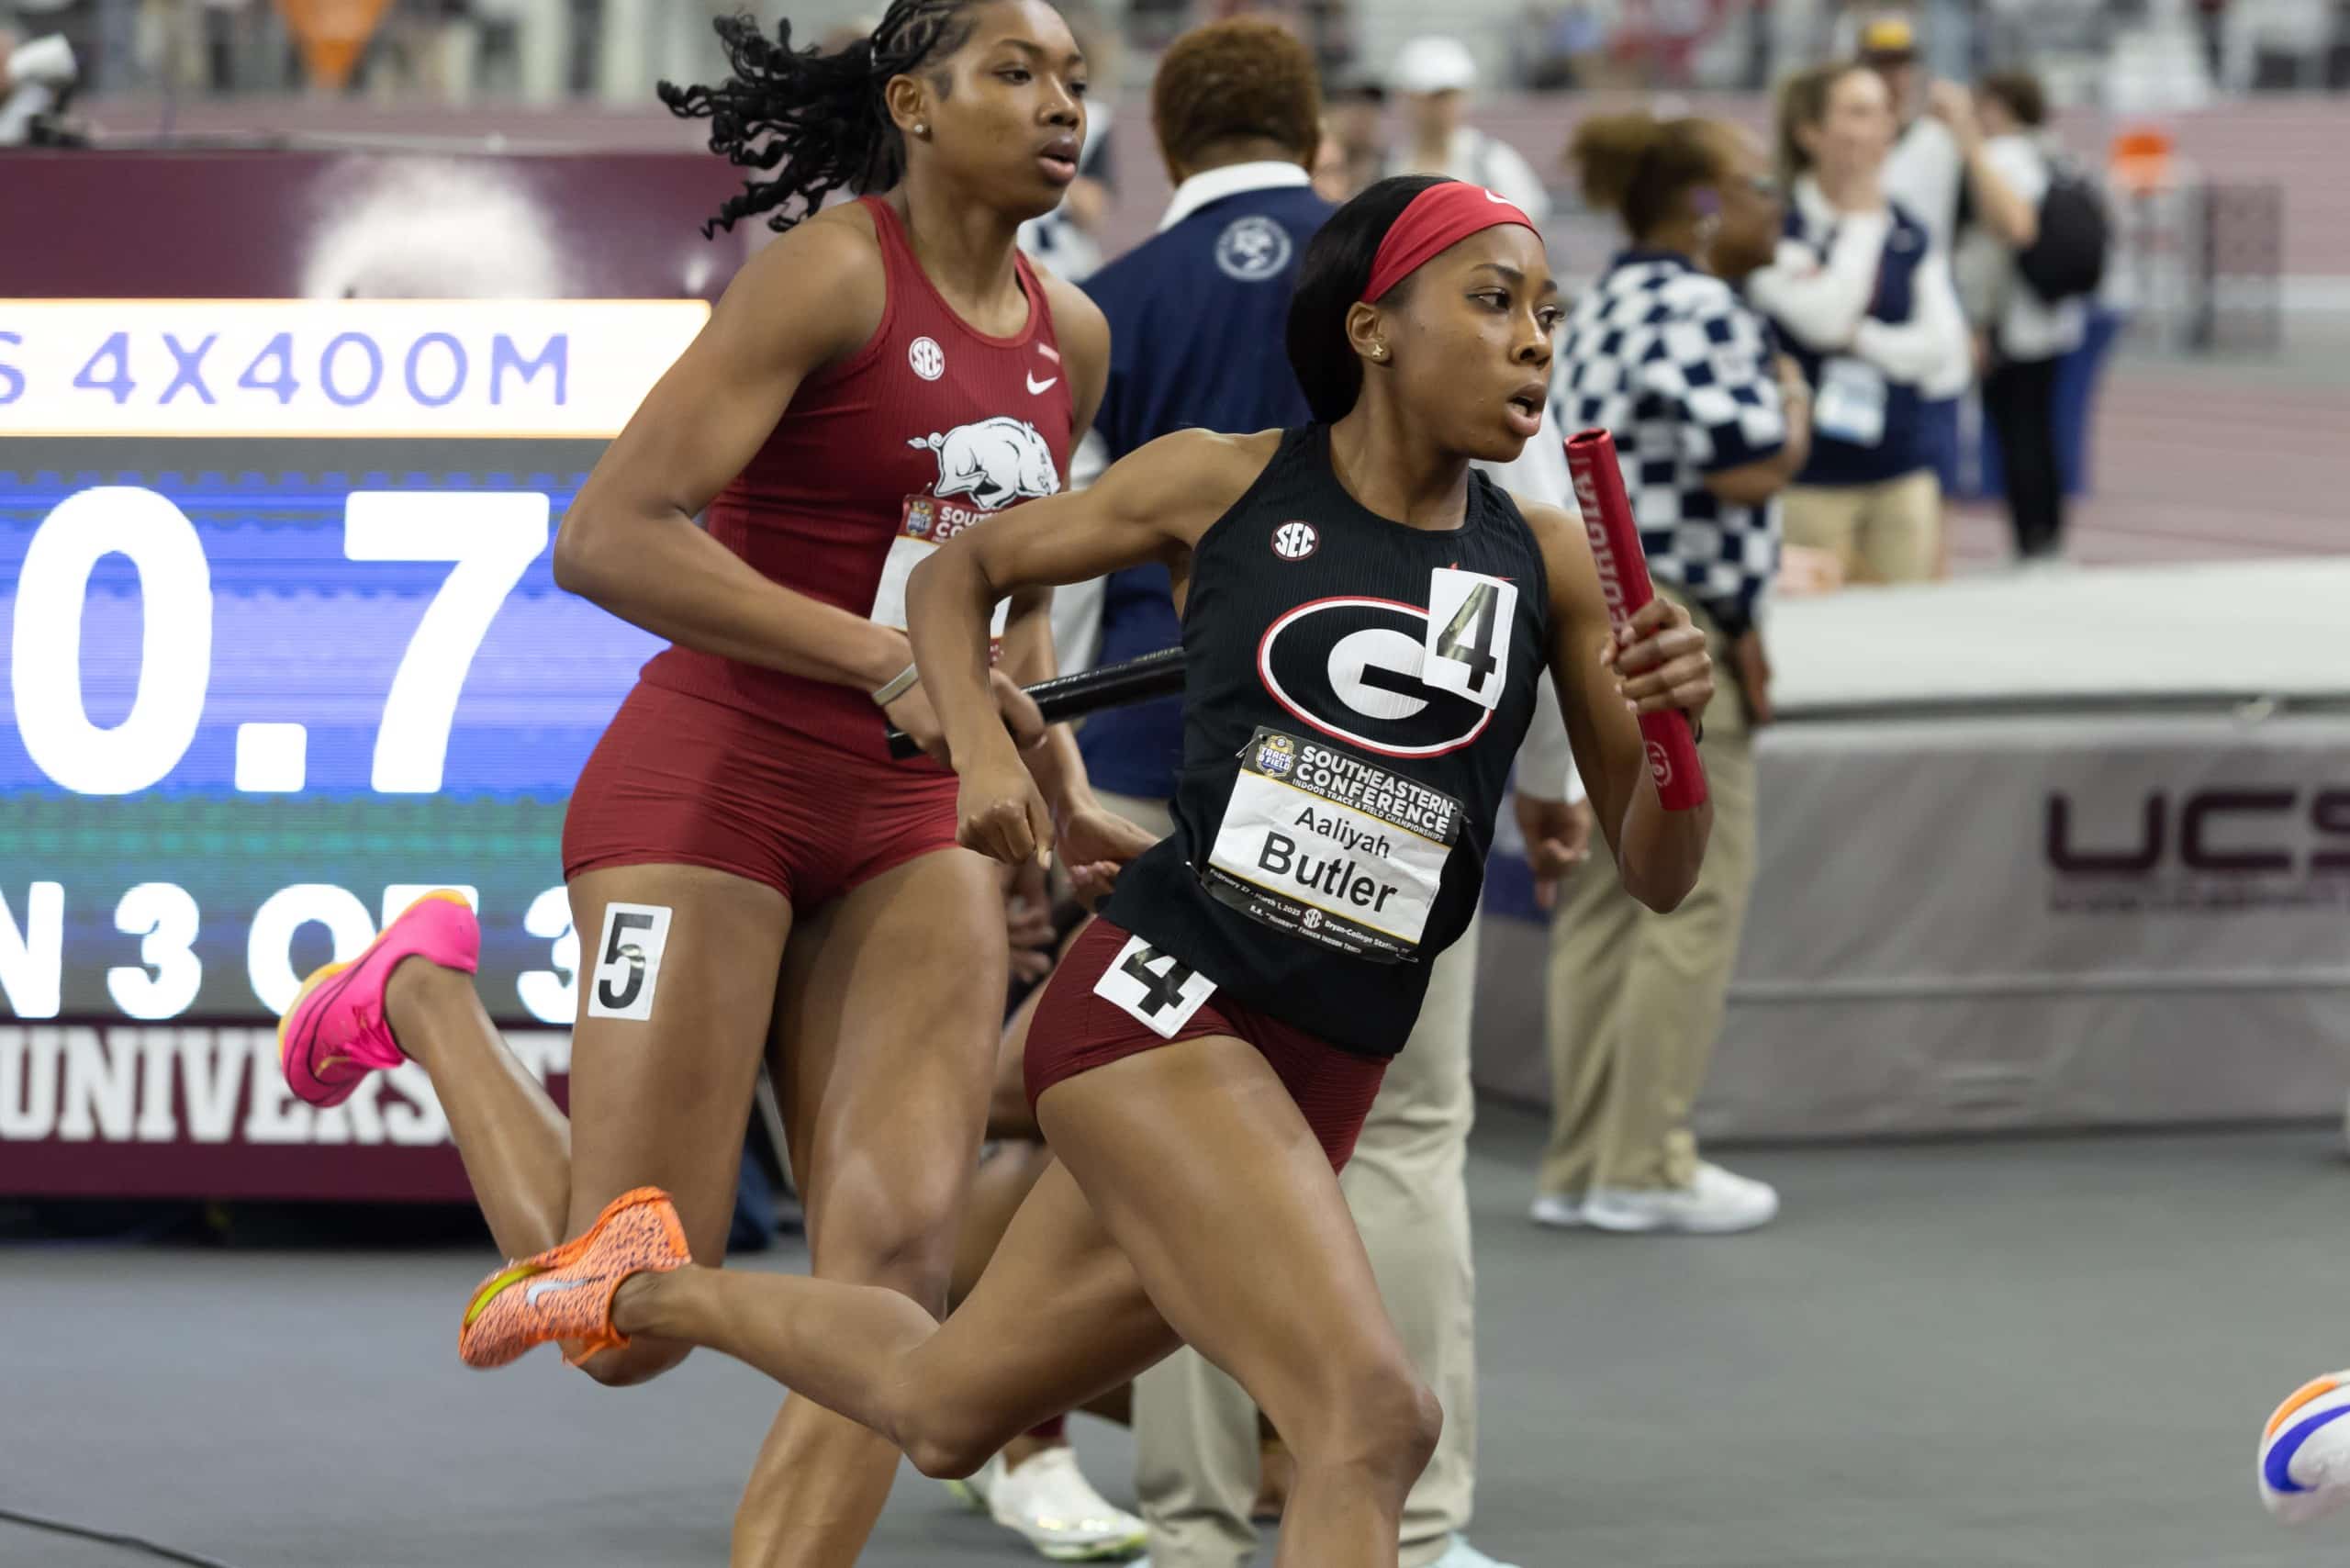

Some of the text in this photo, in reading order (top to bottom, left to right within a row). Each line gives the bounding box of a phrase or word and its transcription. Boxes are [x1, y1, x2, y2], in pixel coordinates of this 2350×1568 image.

[73, 331, 568, 407] 4X400M
[1274, 521, 1315, 558] SEC
[11, 486, 551, 796] 0.7
[1436, 581, 1500, 694] 4
[1265, 756, 1291, 771] FIELD
[1296, 763, 1449, 834] CONFERENCE
[1301, 745, 1453, 817] SOUTHEASTERN
[1292, 778, 1326, 796] INDOOR
[1326, 790, 1354, 806] TRACK
[1361, 803, 1384, 817] FIELD
[1385, 813, 1446, 843] CHAMPIONSHIPS
[1294, 807, 1390, 858] Aaliyah
[1258, 831, 1398, 913] Butler
[107, 882, 202, 1019] 3
[1303, 908, 1322, 929] SEC
[599, 912, 654, 1009] 5
[1120, 946, 1186, 1018] 4
